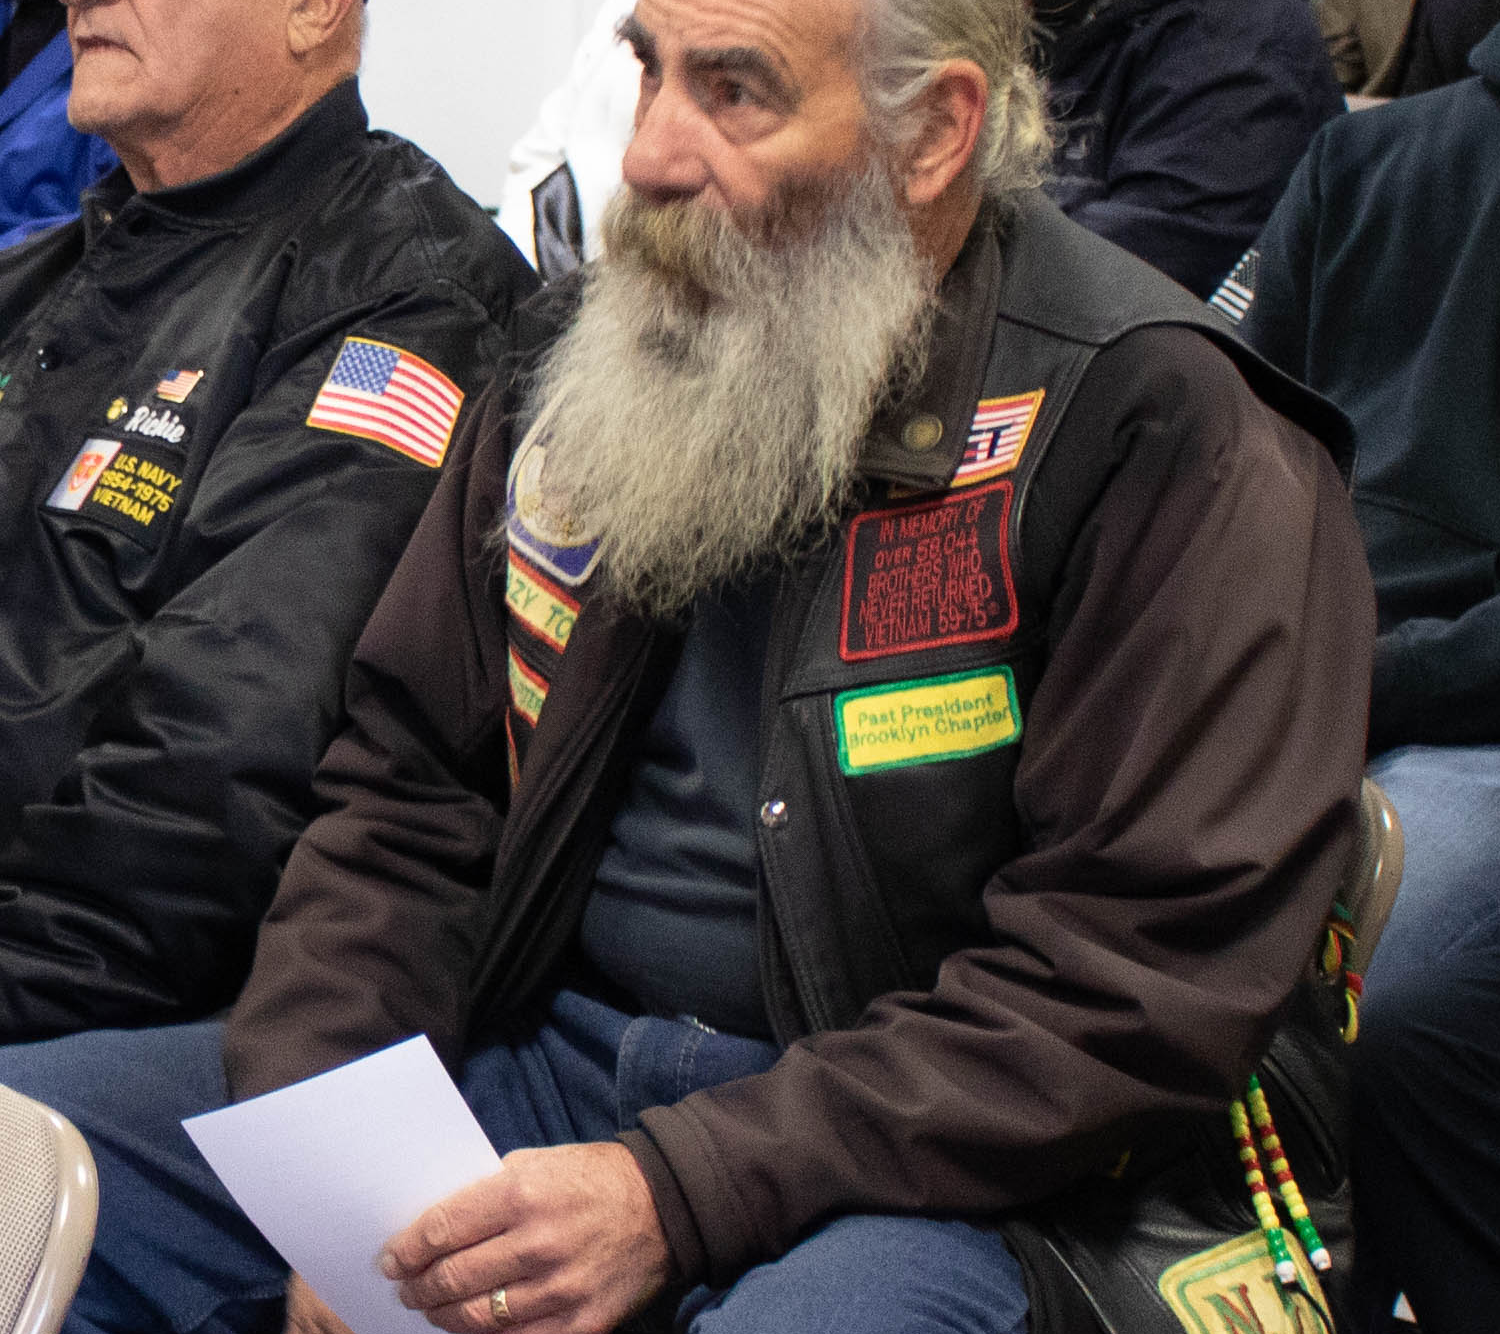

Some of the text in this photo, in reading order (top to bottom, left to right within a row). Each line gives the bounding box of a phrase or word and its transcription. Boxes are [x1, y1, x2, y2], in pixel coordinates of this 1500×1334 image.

[114, 453, 183, 493] U.S. NAVY
[92, 485, 155, 527] VIETNAM
[880, 497, 986, 544] IN MEMORY OF
[868, 548, 982, 598] BROTHERS WHO
[874, 546, 912, 569] OVER
[859, 573, 992, 625] NEVER RETURNED
[865, 610, 931, 650] VIETNAM
[850, 707, 1009, 749] Brooklyn Chapter
[858, 692, 994, 728] Past President
